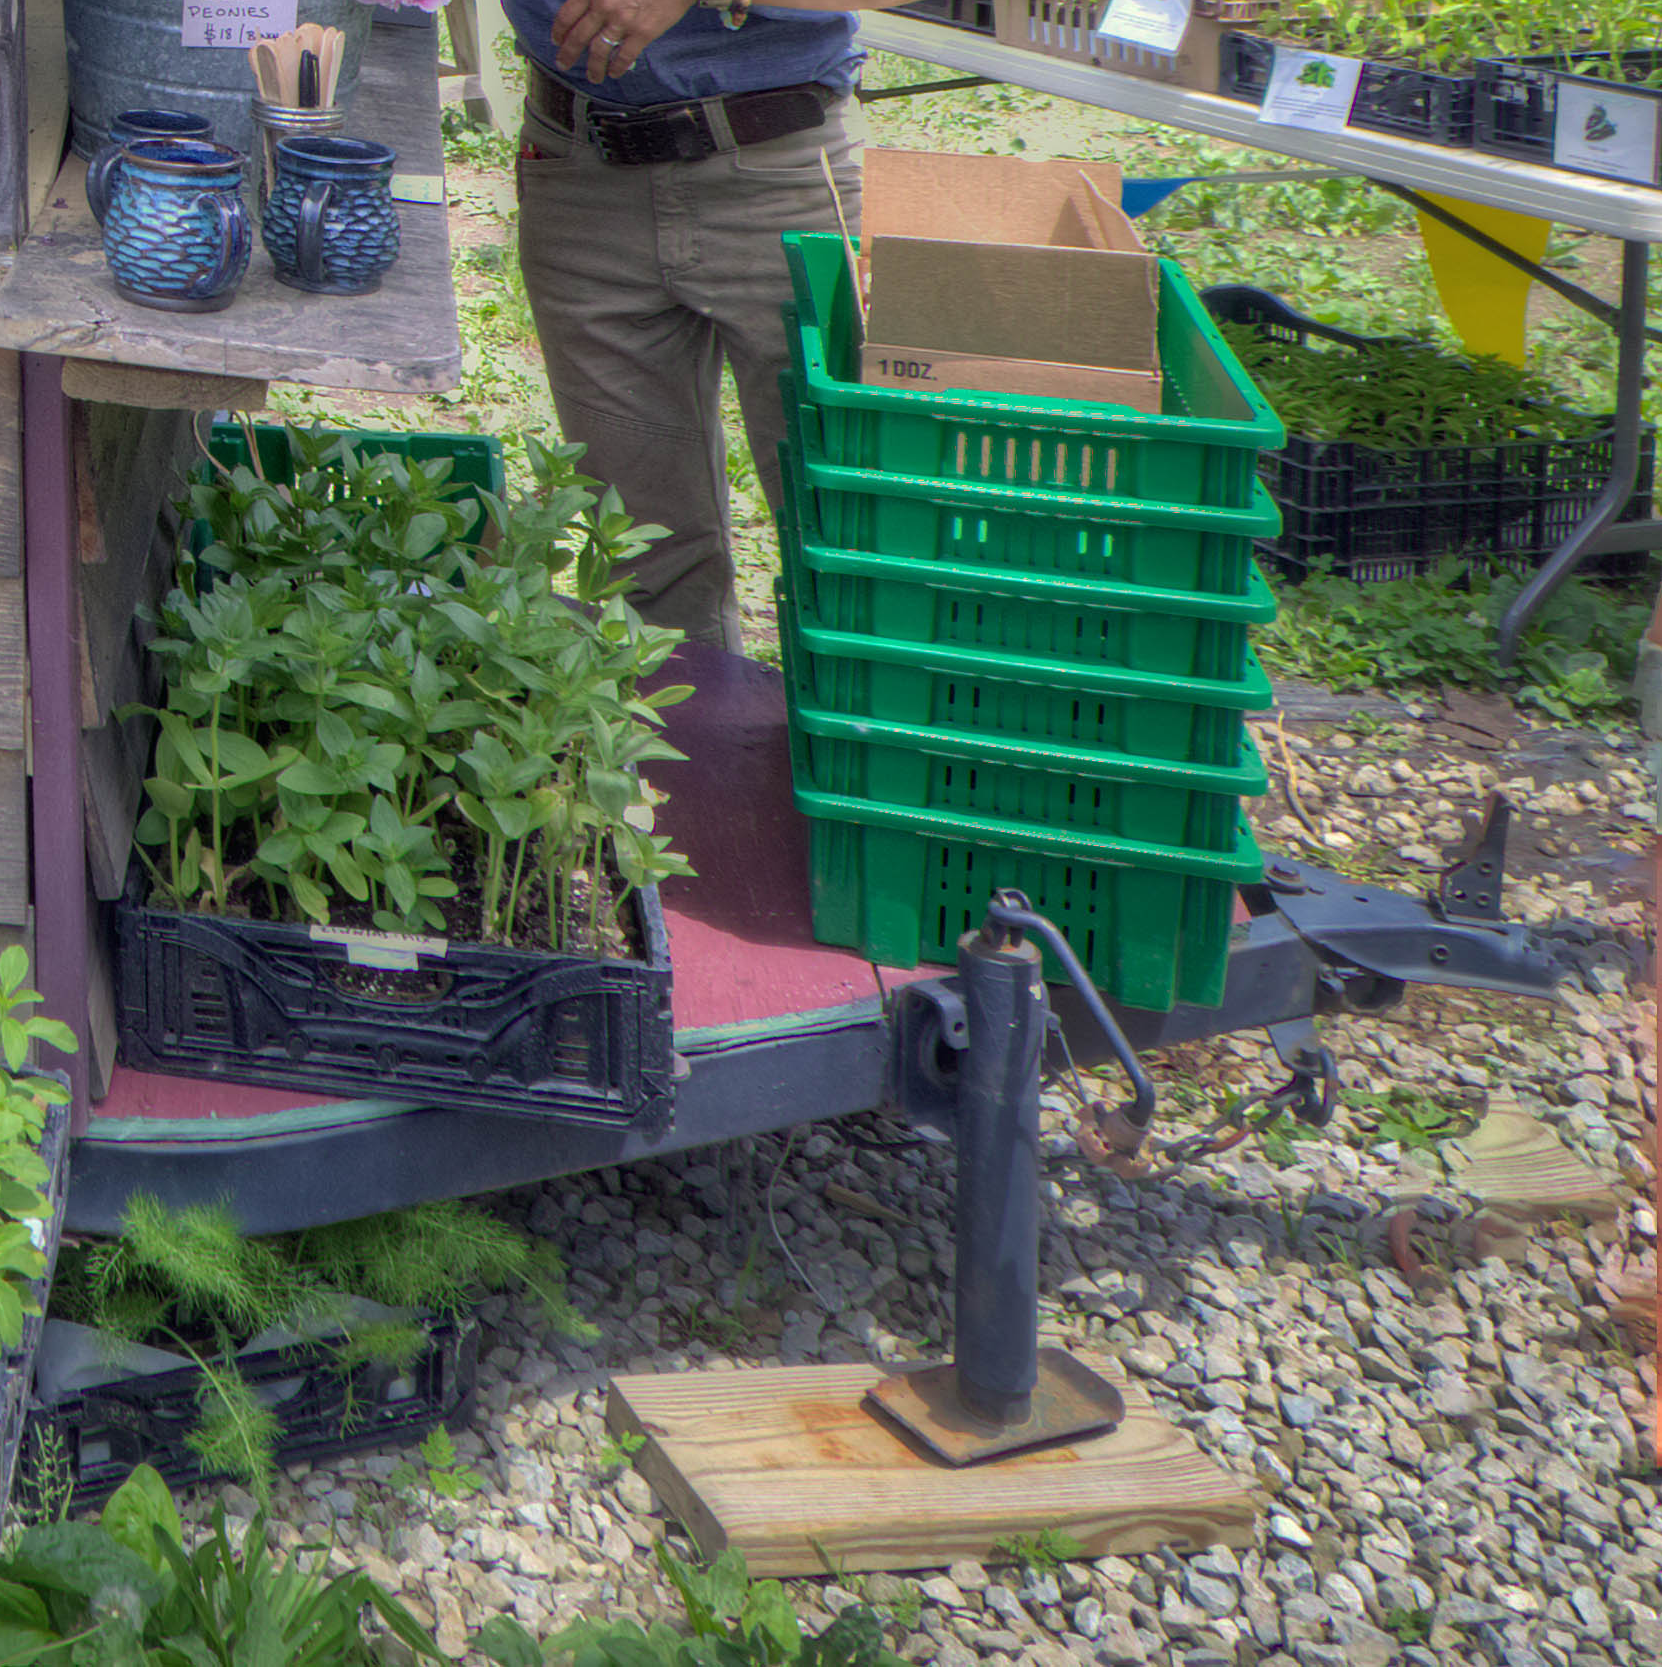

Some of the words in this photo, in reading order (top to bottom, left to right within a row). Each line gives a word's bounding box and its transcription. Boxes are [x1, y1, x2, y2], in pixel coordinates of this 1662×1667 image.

[187, 5, 270, 19] PEONIES
[878, 359, 887, 375] 1
[893, 360, 938, 381] DOZ.
